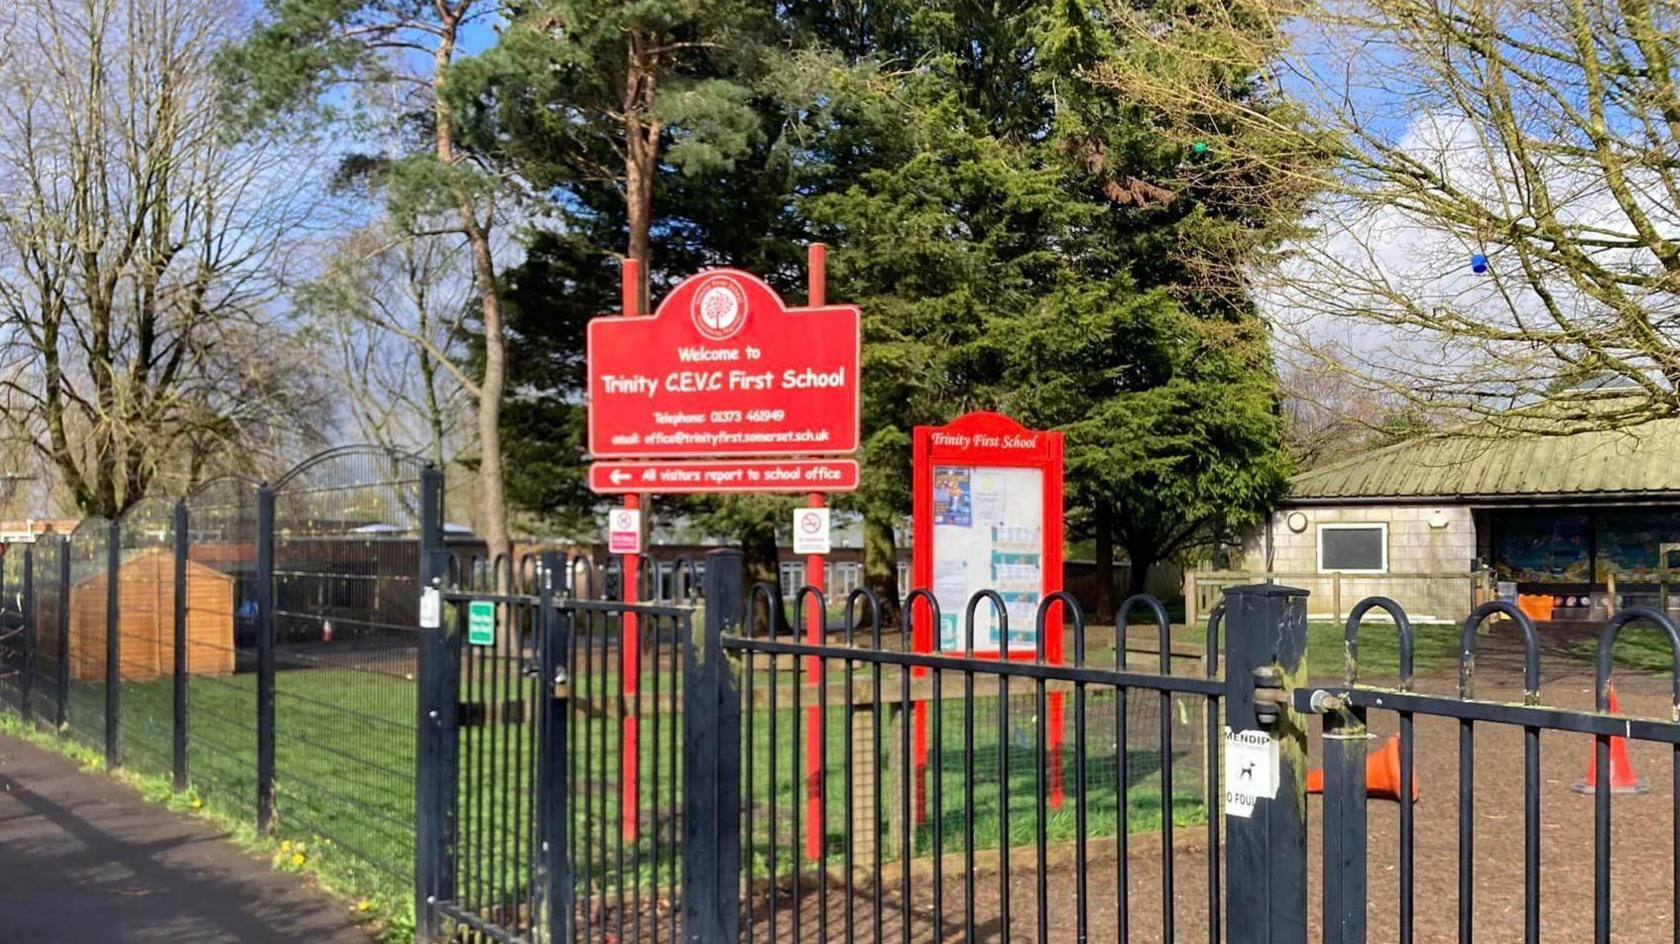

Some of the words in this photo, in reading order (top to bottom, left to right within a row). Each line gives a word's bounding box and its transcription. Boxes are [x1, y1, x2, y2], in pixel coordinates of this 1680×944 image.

[678, 345, 739, 362] Welcome
[745, 345, 761, 360] to
[601, 374, 659, 398] Trinity
[729, 370, 774, 391] First
[781, 366, 845, 389] School
[932, 432, 970, 450] Trinity
[973, 434, 999, 447] First
[1001, 434, 1038, 449] School
[642, 469, 656, 481] All
[661, 468, 700, 482] visitors
[705, 467, 743, 484] report
[747, 467, 760, 480] to
[764, 466, 800, 481] school
[804, 465, 842, 480] office
